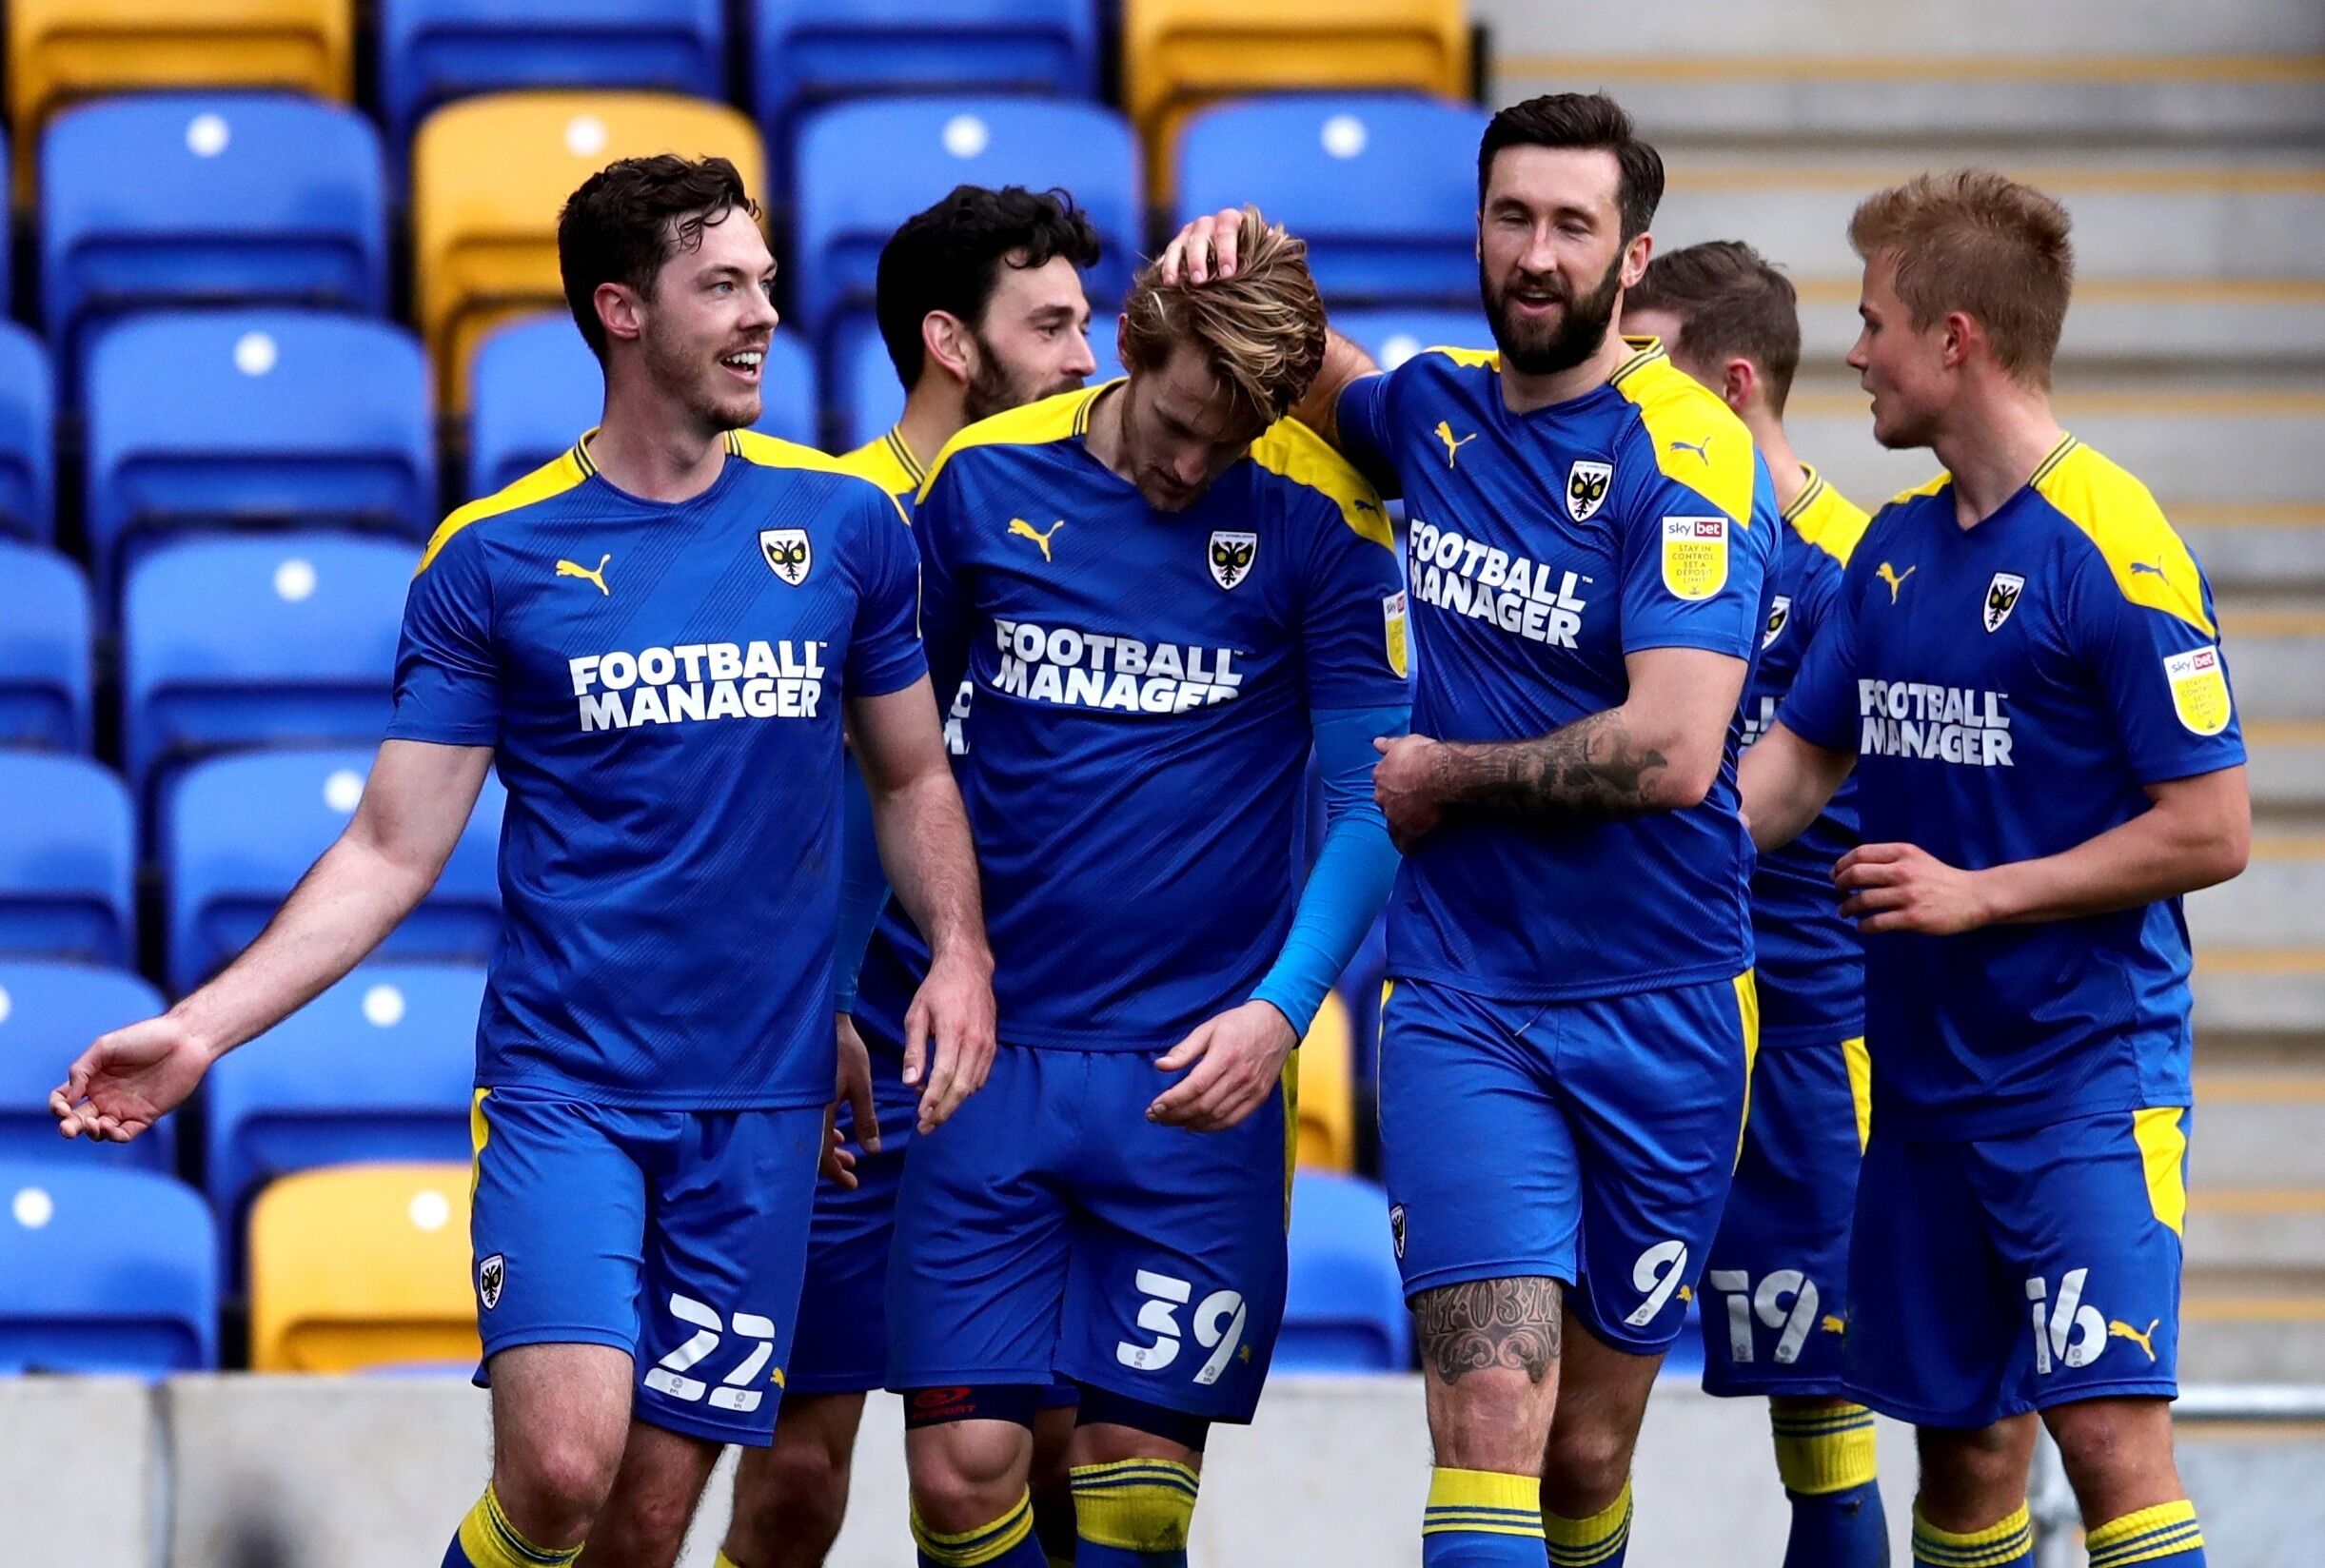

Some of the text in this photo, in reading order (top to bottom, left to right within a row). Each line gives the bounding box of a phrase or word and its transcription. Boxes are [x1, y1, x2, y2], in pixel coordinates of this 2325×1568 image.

[1409, 519, 1586, 613] FOOTBALL
[1668, 521, 1721, 536] sky bet
[1409, 558, 1582, 650] MANAGER
[569, 640, 826, 696] FOOTBALL
[994, 618, 1243, 686] FOOTBALL
[2172, 660, 2191, 674] sky
[579, 678, 821, 732] MANAGER
[1858, 678, 2010, 729] FOOTBALL
[1860, 716, 2015, 767] MANAGER
[1623, 1240, 1688, 1325] 9
[1710, 1269, 1820, 1364] 19
[643, 1293, 776, 1413] 22
[1115, 1269, 1247, 1385] 39
[2025, 1267, 2107, 1375] 16
